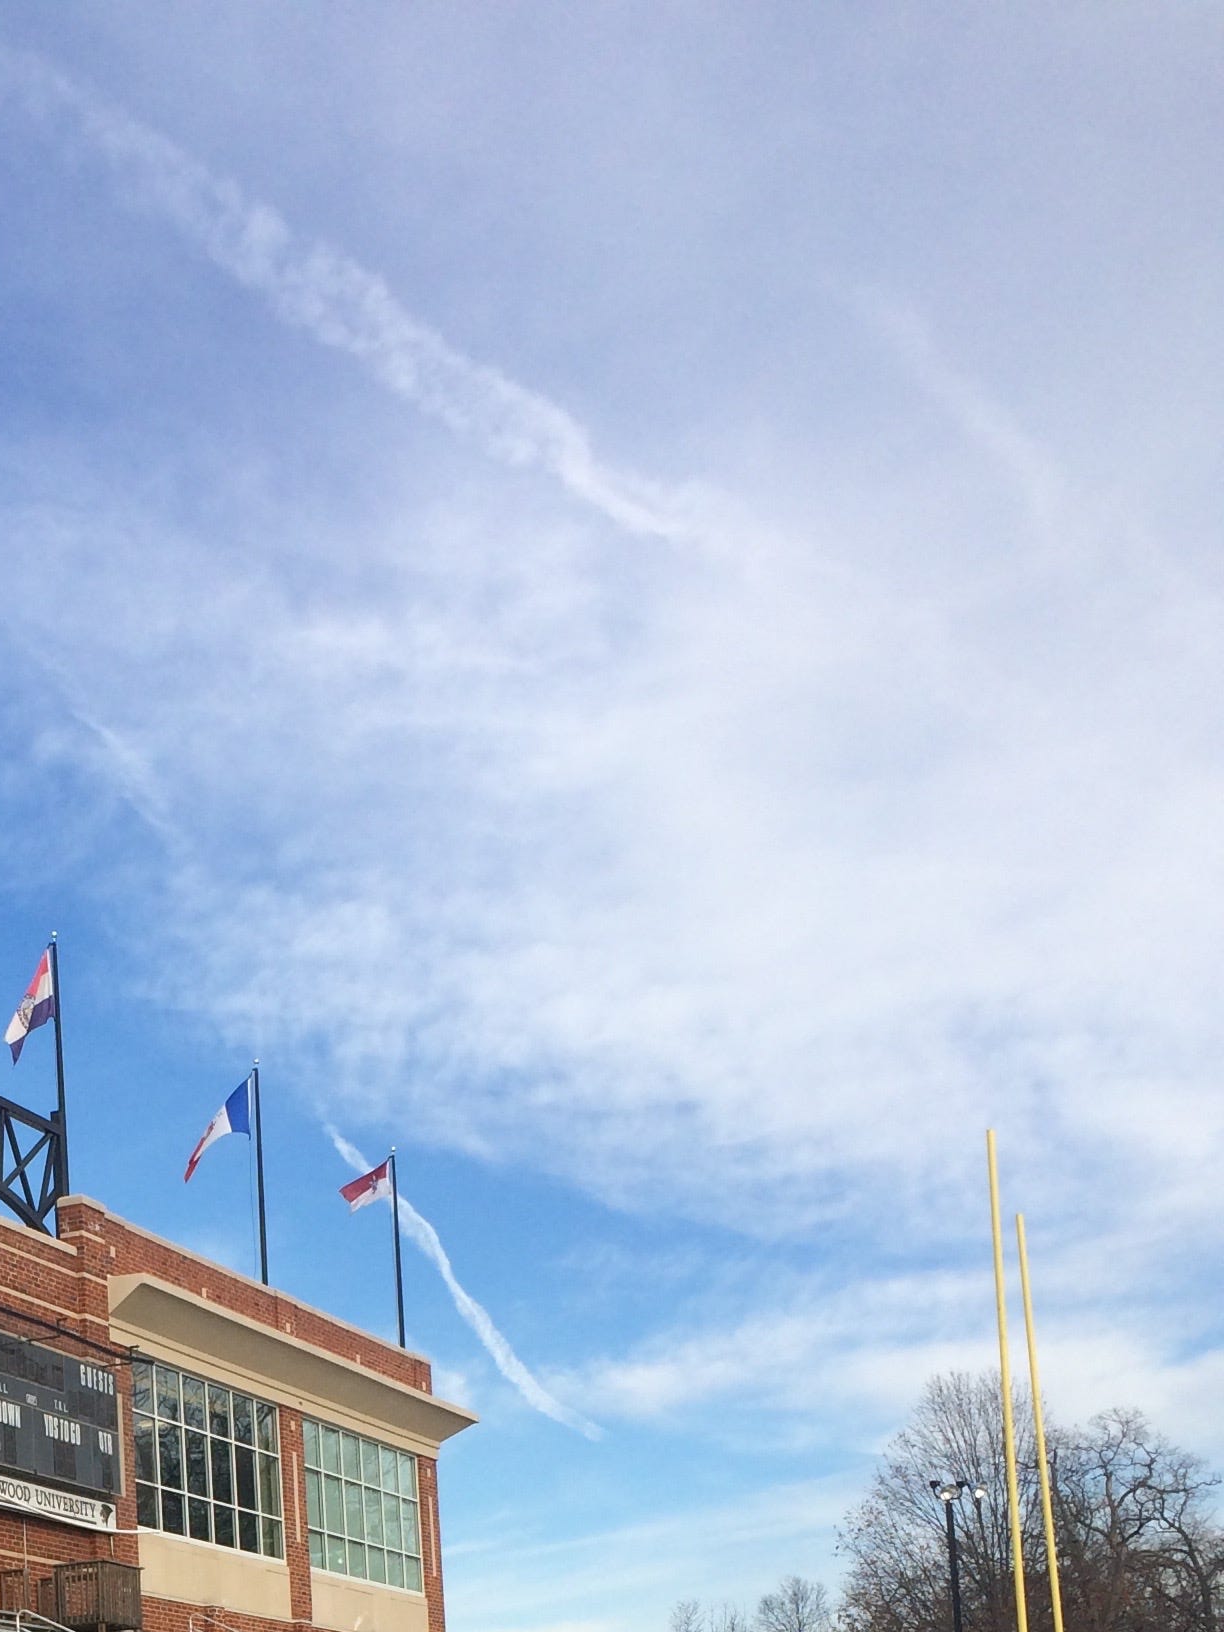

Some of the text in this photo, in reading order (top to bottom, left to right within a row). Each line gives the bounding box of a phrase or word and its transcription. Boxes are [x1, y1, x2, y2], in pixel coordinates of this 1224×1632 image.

[80, 1364, 114, 1396] GUESTS
[43, 1413, 81, 1446] YDS TO GO
[98, 1430, 113, 1456] QTR
[34, 1488, 96, 1518] UNIVERSITY
